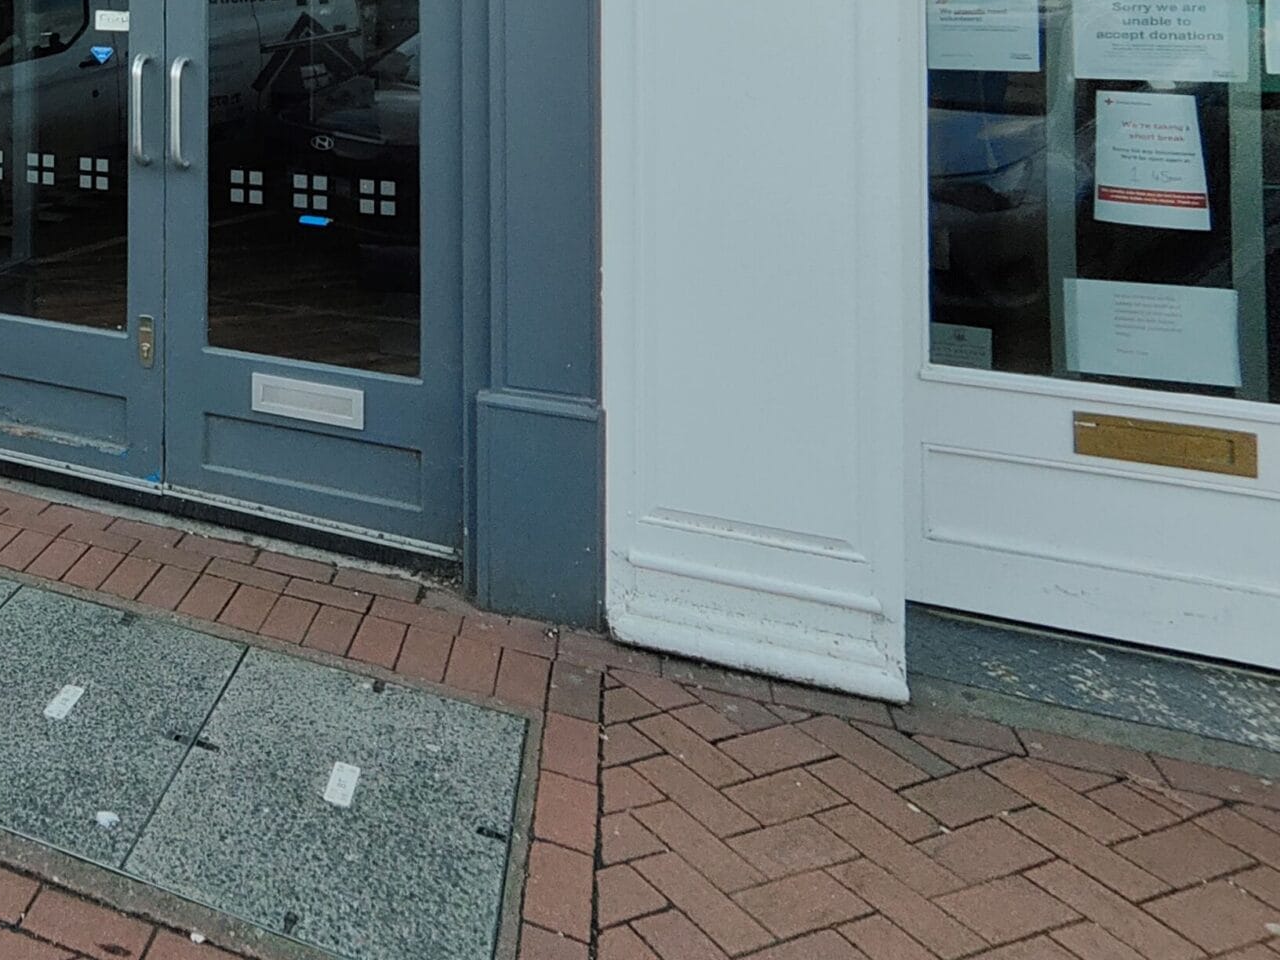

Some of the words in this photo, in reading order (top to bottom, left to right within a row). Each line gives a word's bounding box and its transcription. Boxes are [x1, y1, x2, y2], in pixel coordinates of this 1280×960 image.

[1112, 2, 1152, 14] Sorry
[1156, 4, 1178, 12] we
[1182, 4, 1206, 12] are
[1122, 16, 1171, 26] unable
[1177, 17, 1191, 26] to
[1096, 31, 1145, 43] accept
[1149, 30, 1224, 41] donations
